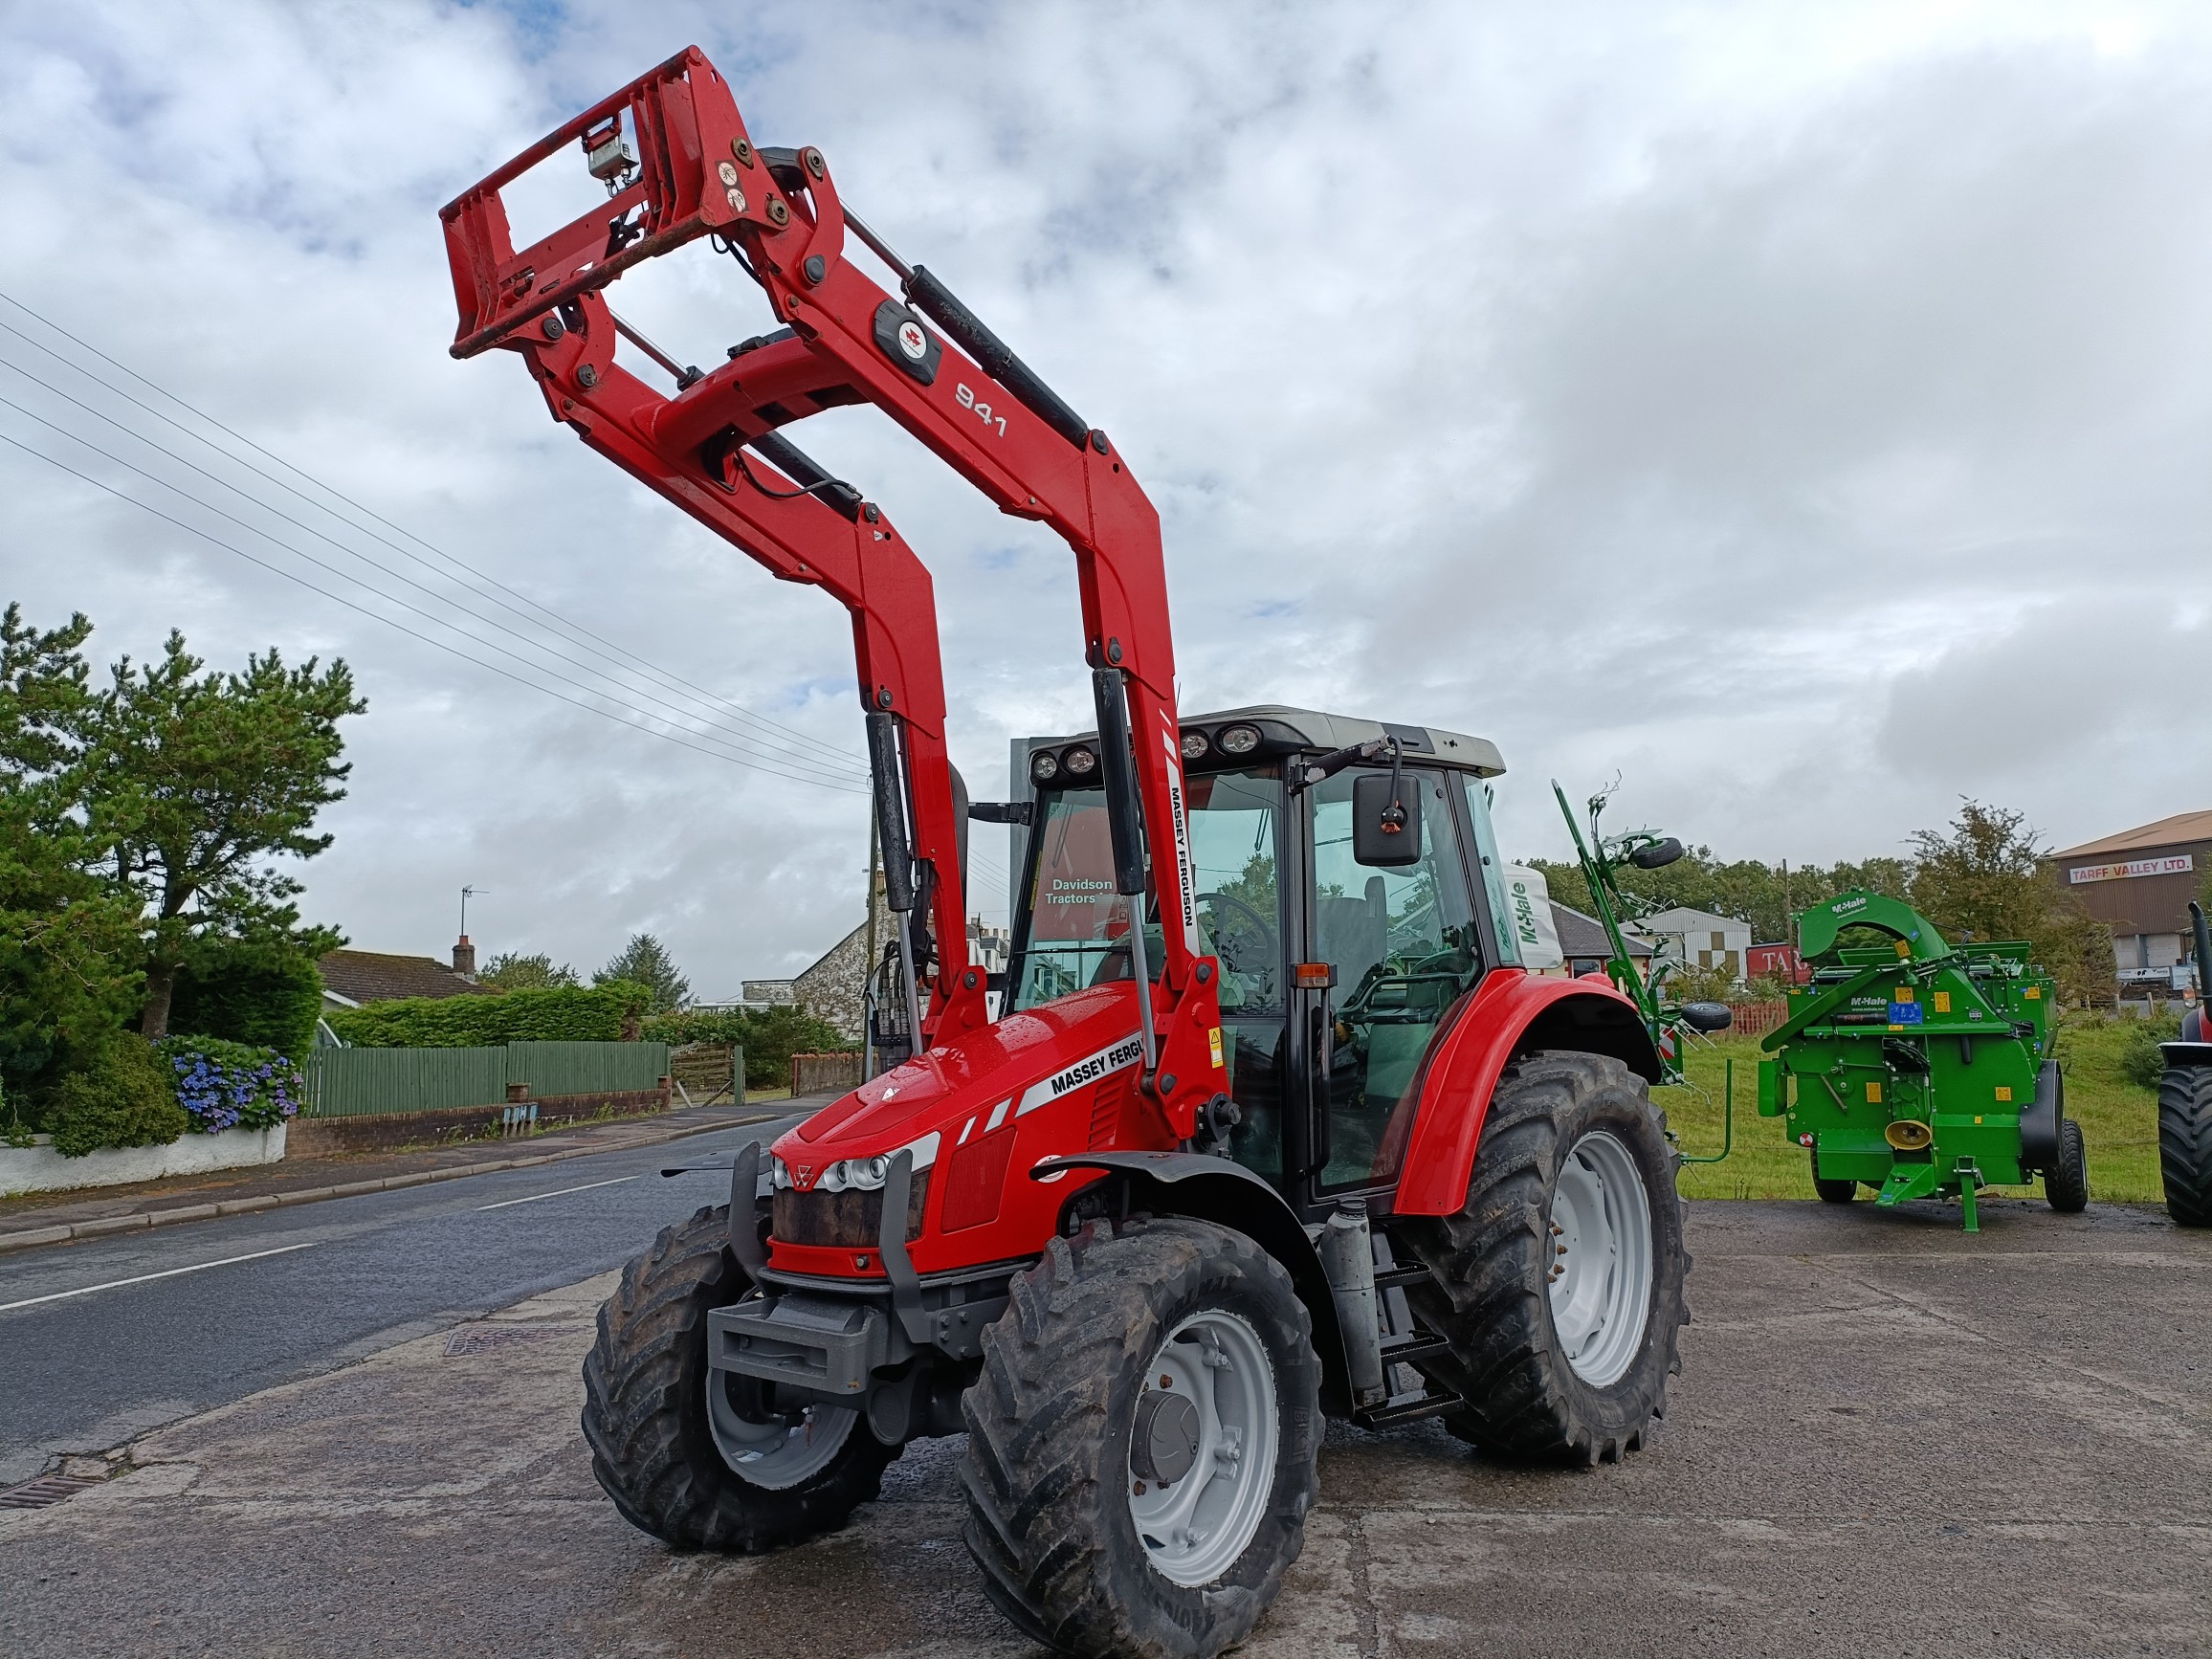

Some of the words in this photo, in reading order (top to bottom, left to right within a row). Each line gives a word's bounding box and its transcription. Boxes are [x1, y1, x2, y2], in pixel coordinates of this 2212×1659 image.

[955, 383, 1007, 438] 941
[1171, 787, 1185, 846] MASSEY
[1179, 851, 1193, 927] FERGUSON
[2072, 868, 2109, 880] TARFF
[2112, 861, 2159, 876] VALLEY
[2163, 858, 2190, 872] LTD.
[1045, 893, 1095, 904] Tractors
[1052, 878, 1113, 891] Davidson
[1051, 1055, 1106, 1095] MASSEY
[1108, 1038, 1144, 1068] FERGU
[1293, 1408, 1311, 1460] BKT
